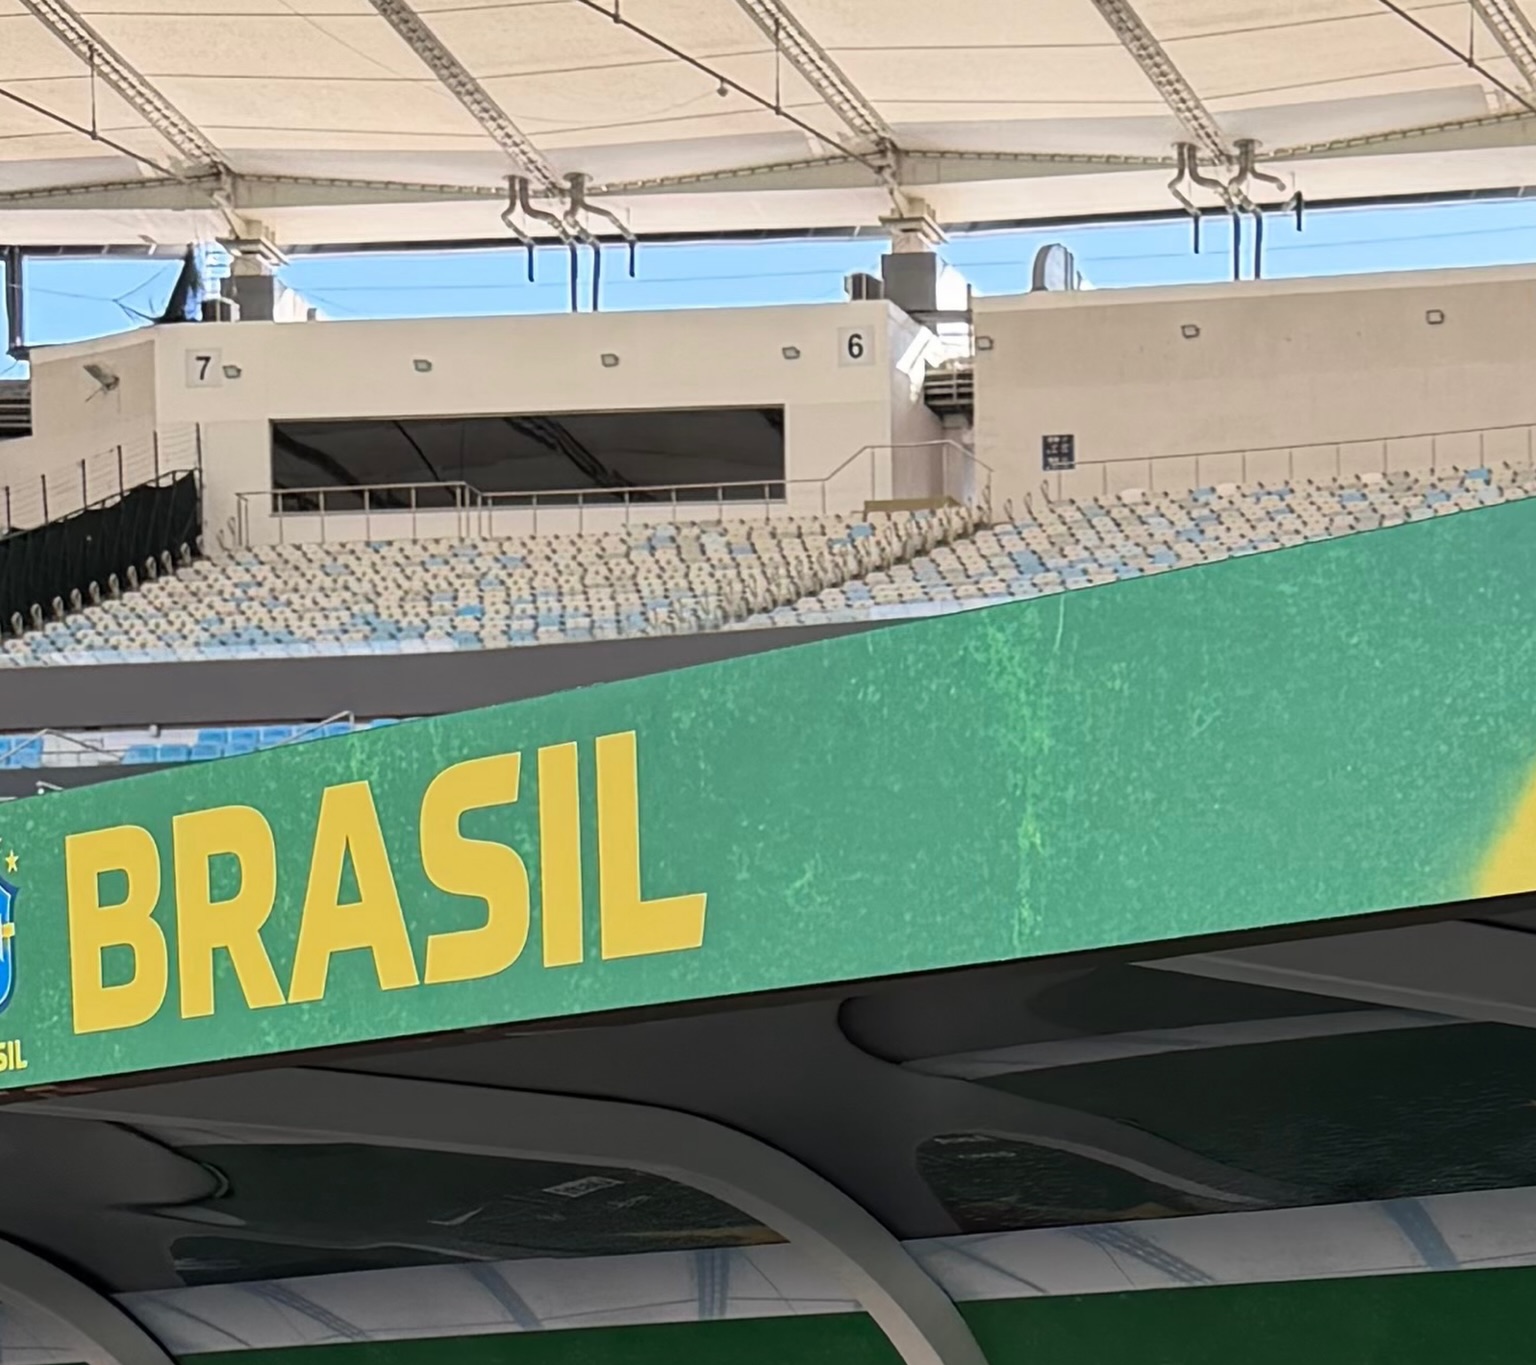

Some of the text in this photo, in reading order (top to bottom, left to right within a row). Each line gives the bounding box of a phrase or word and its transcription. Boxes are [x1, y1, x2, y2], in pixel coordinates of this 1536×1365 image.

[848, 333, 864, 359] 6
[195, 355, 212, 380] 7
[64, 729, 709, 1035] BRASIL
